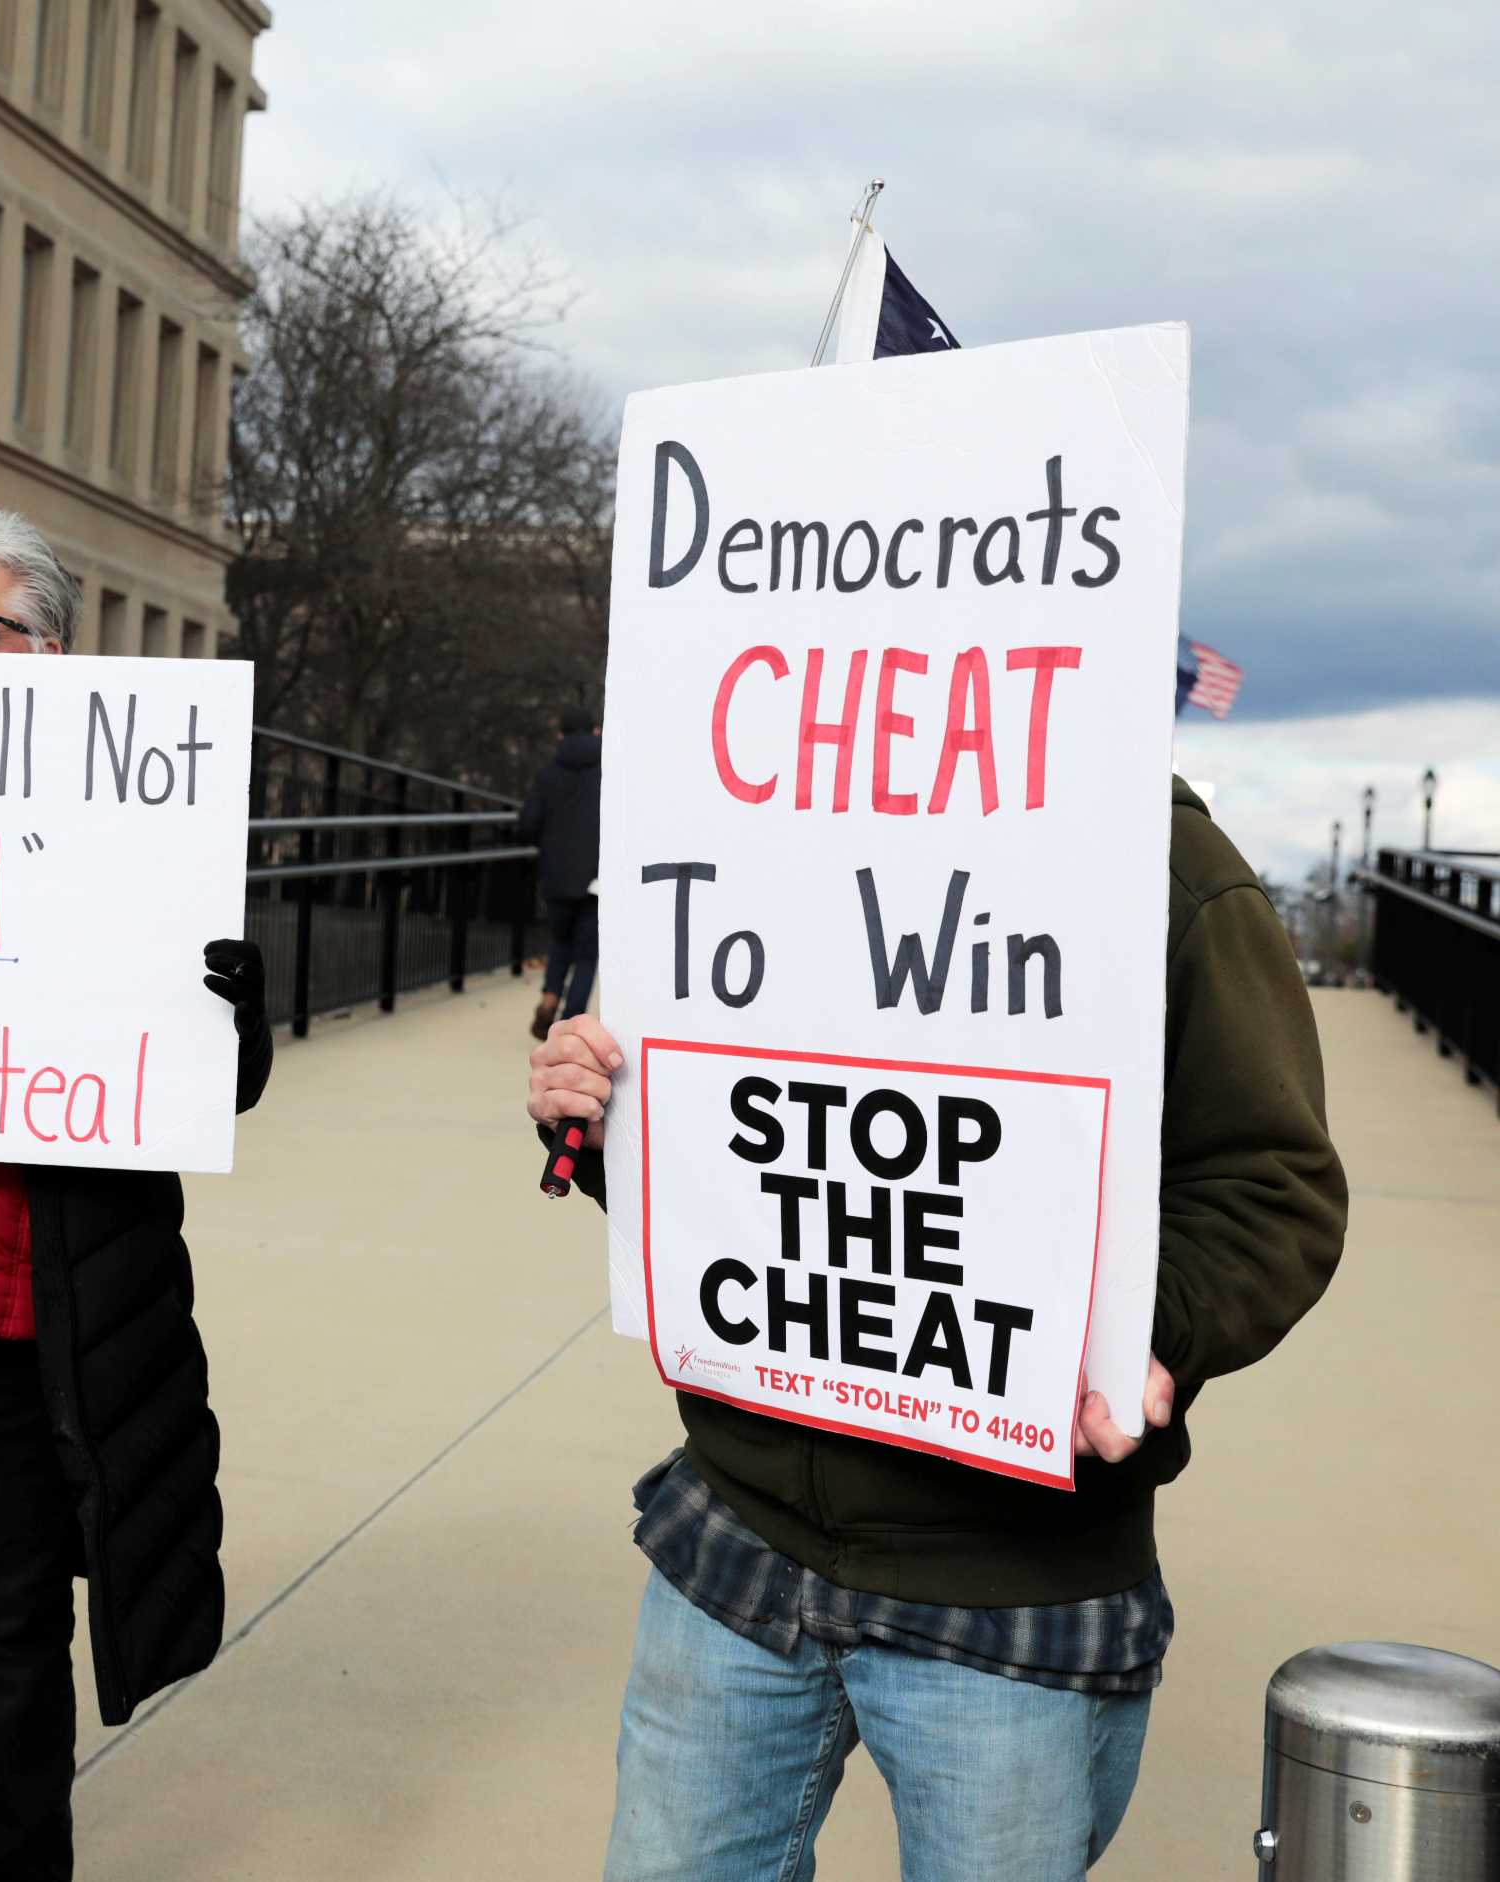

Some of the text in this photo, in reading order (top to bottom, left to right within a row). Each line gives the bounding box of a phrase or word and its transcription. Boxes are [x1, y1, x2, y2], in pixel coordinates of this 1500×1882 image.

[648, 441, 1120, 593] Democrats
[85, 692, 212, 805] Not
[712, 645, 1082, 817] CHEAT
[641, 862, 1063, 1019] To Win
[728, 1076, 1001, 1186] STOP
[760, 1172, 964, 1287] THE
[700, 1257, 1034, 1398] CHEAT
[755, 1365, 815, 1397] TEXT
[948, 1405, 980, 1433] TO
[986, 1415, 1055, 1452] 41490
